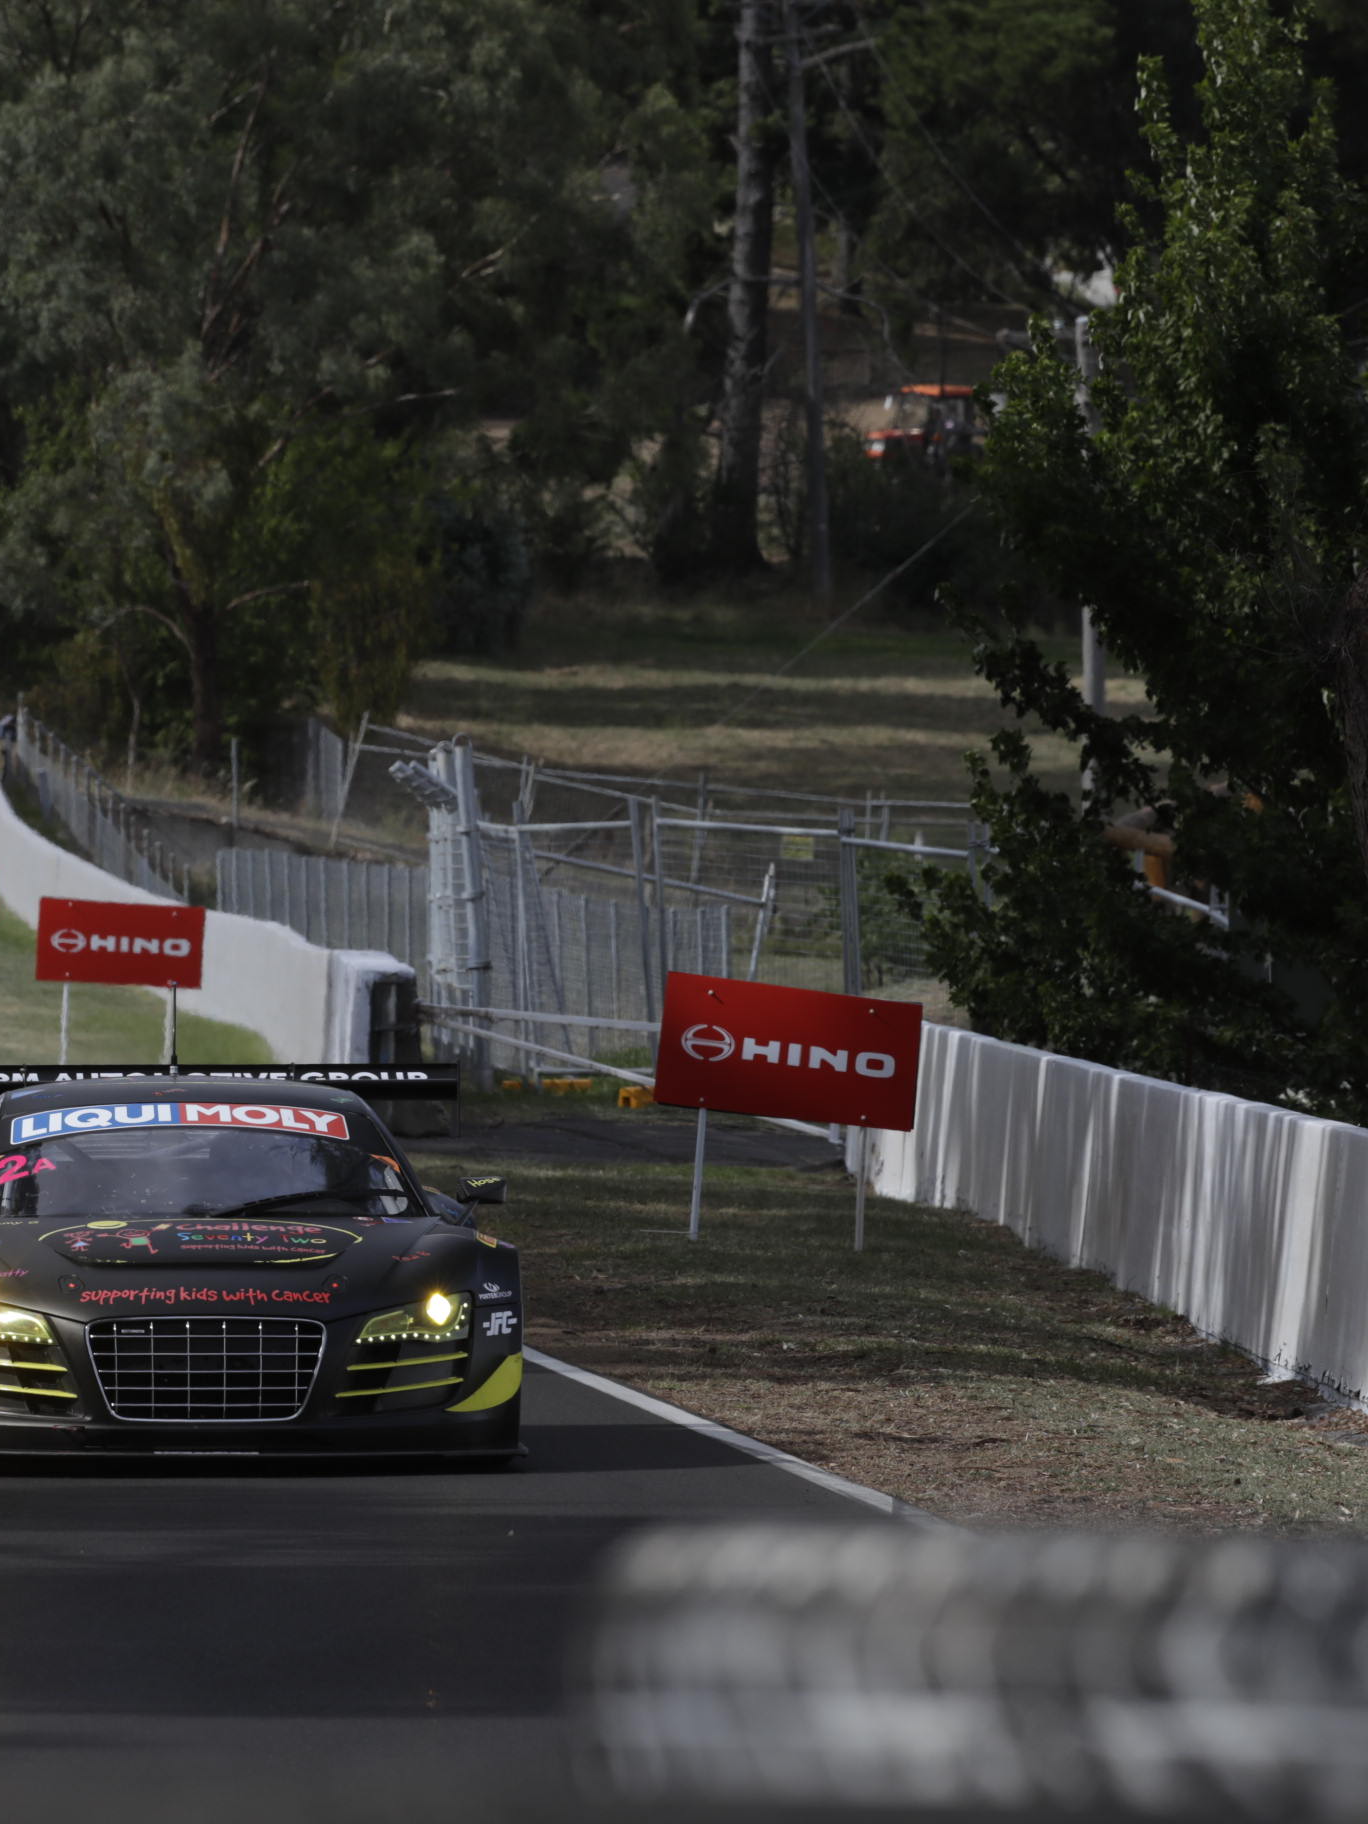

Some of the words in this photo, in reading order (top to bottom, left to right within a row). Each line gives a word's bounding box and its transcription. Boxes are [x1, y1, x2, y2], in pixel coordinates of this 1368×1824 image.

[90, 936, 191, 957] HINO
[741, 1037, 896, 1079] HINO
[21, 1104, 172, 1139] LIQUI
[186, 1104, 339, 1133] MOLY
[177, 1232, 269, 1244] Seventy
[280, 1234, 327, 1244] Two
[80, 1288, 176, 1304] supporting
[181, 1286, 218, 1301] kids
[222, 1288, 268, 1305] with
